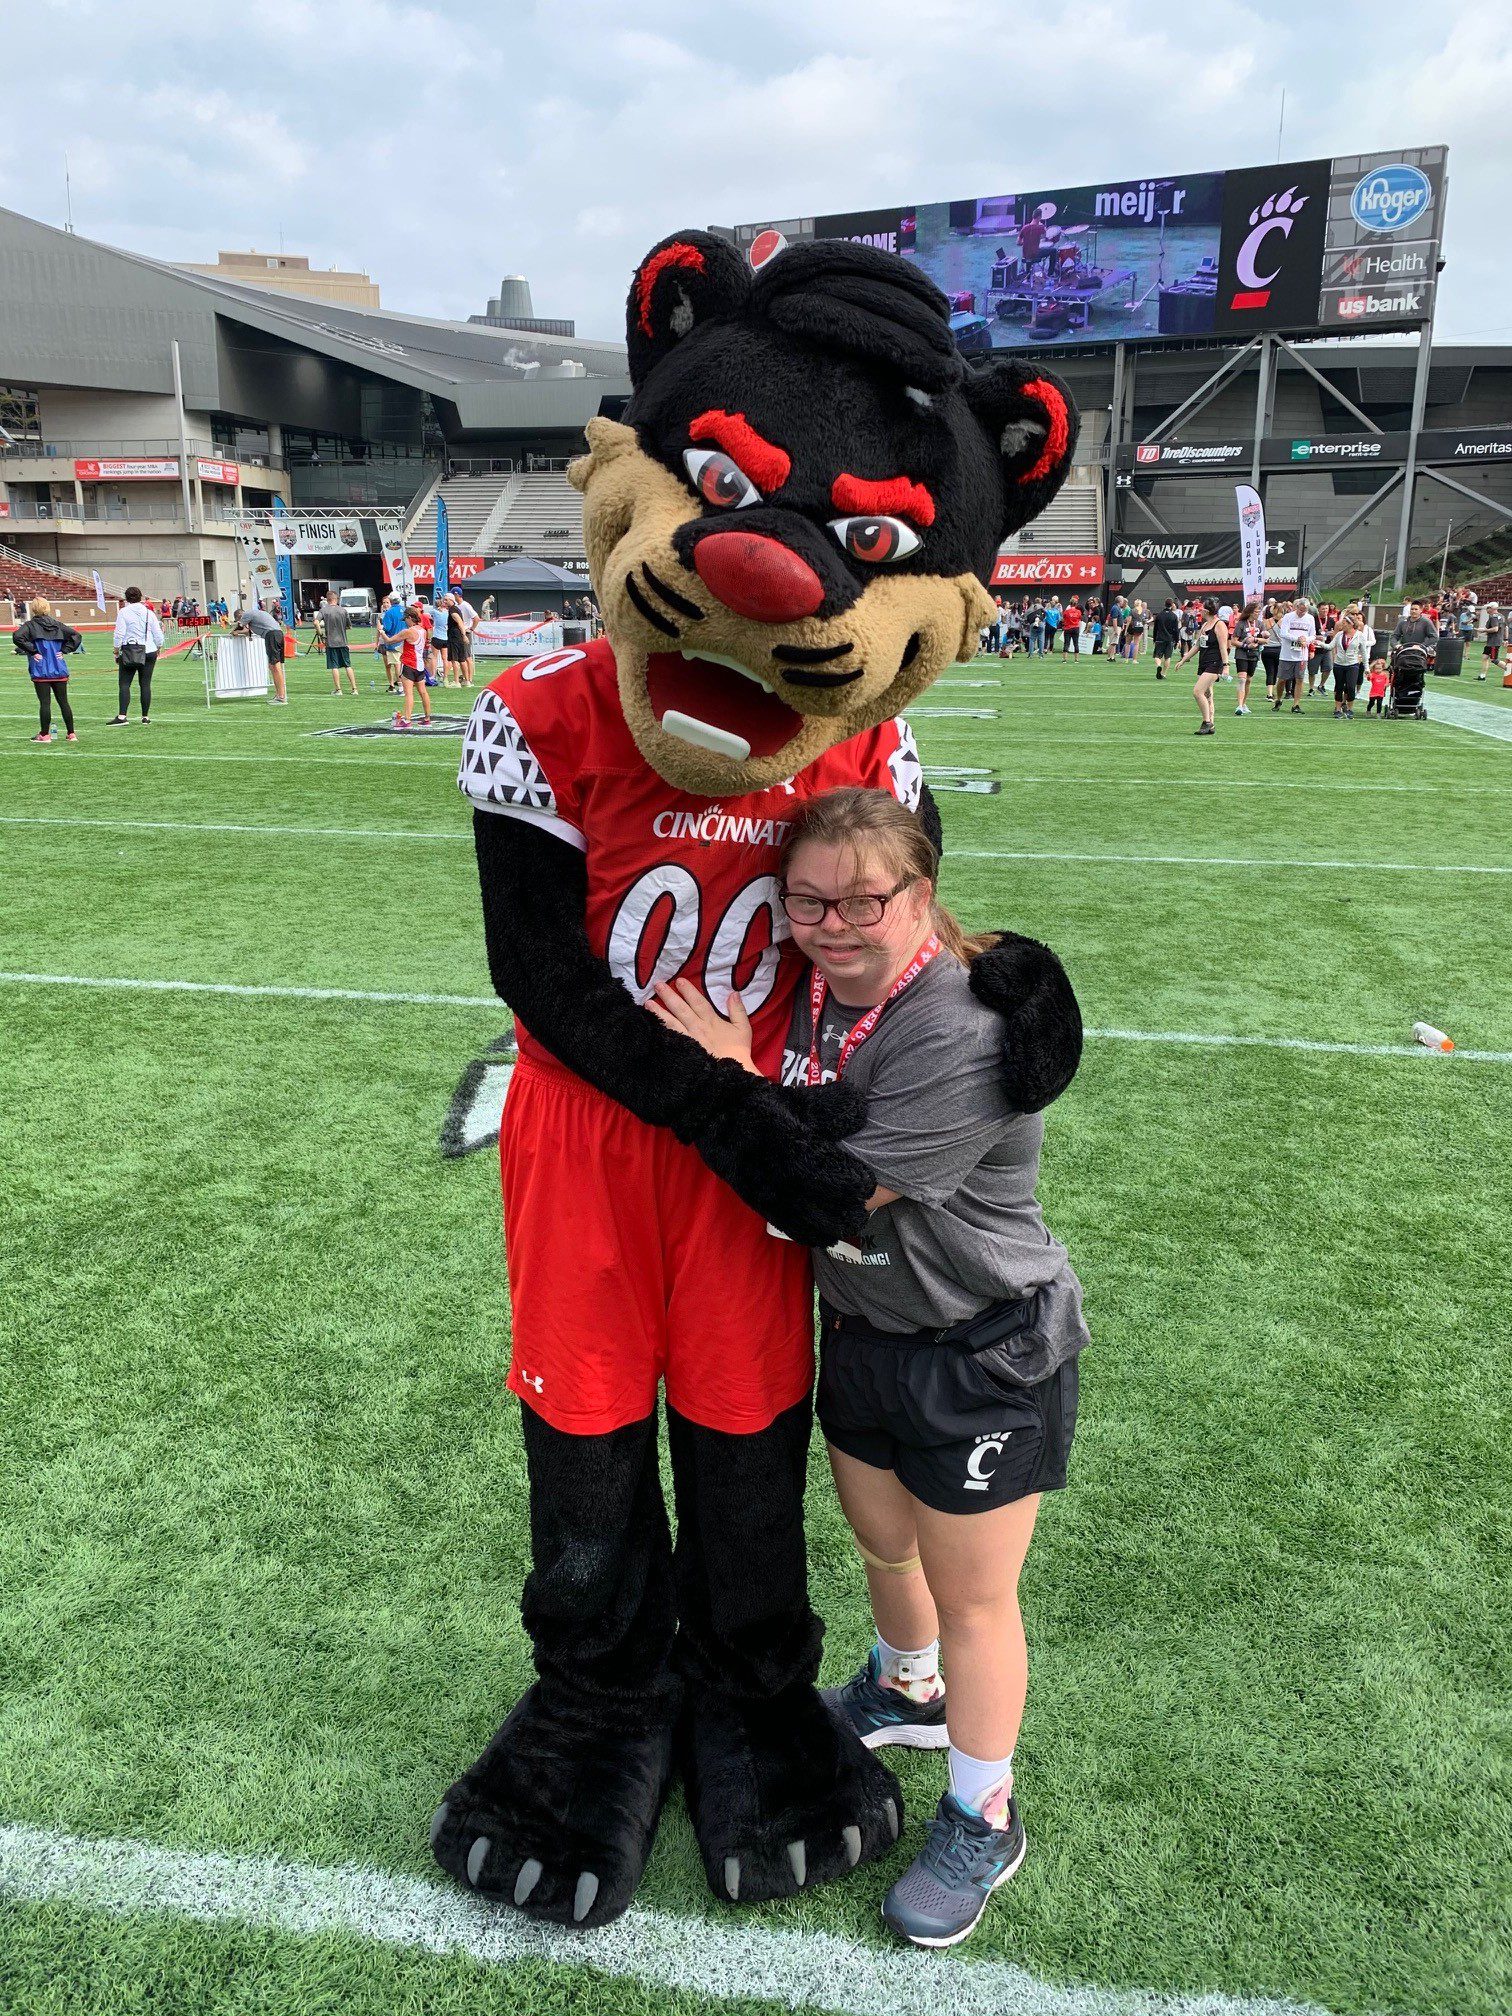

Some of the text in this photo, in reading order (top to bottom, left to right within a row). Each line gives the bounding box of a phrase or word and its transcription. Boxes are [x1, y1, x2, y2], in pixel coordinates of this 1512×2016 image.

[1095, 182, 1186, 223] meijr
[1361, 178, 1424, 222] Kroger
[1367, 253, 1424, 273] Health
[1297, 441, 1381, 456] enterprise
[1455, 442, 1512, 455] Ameritas
[299, 524, 336, 539] FINISH
[1114, 540, 1199, 559] CINCINNATI
[412, 561, 477, 579] BEAATS
[563, 562, 574, 570] 28
[997, 560, 1074, 579] BEARCATS
[652, 808, 791, 847] CINCINNAT
[606, 862, 793, 1020] 00
[812, 970, 826, 1004] DAS
